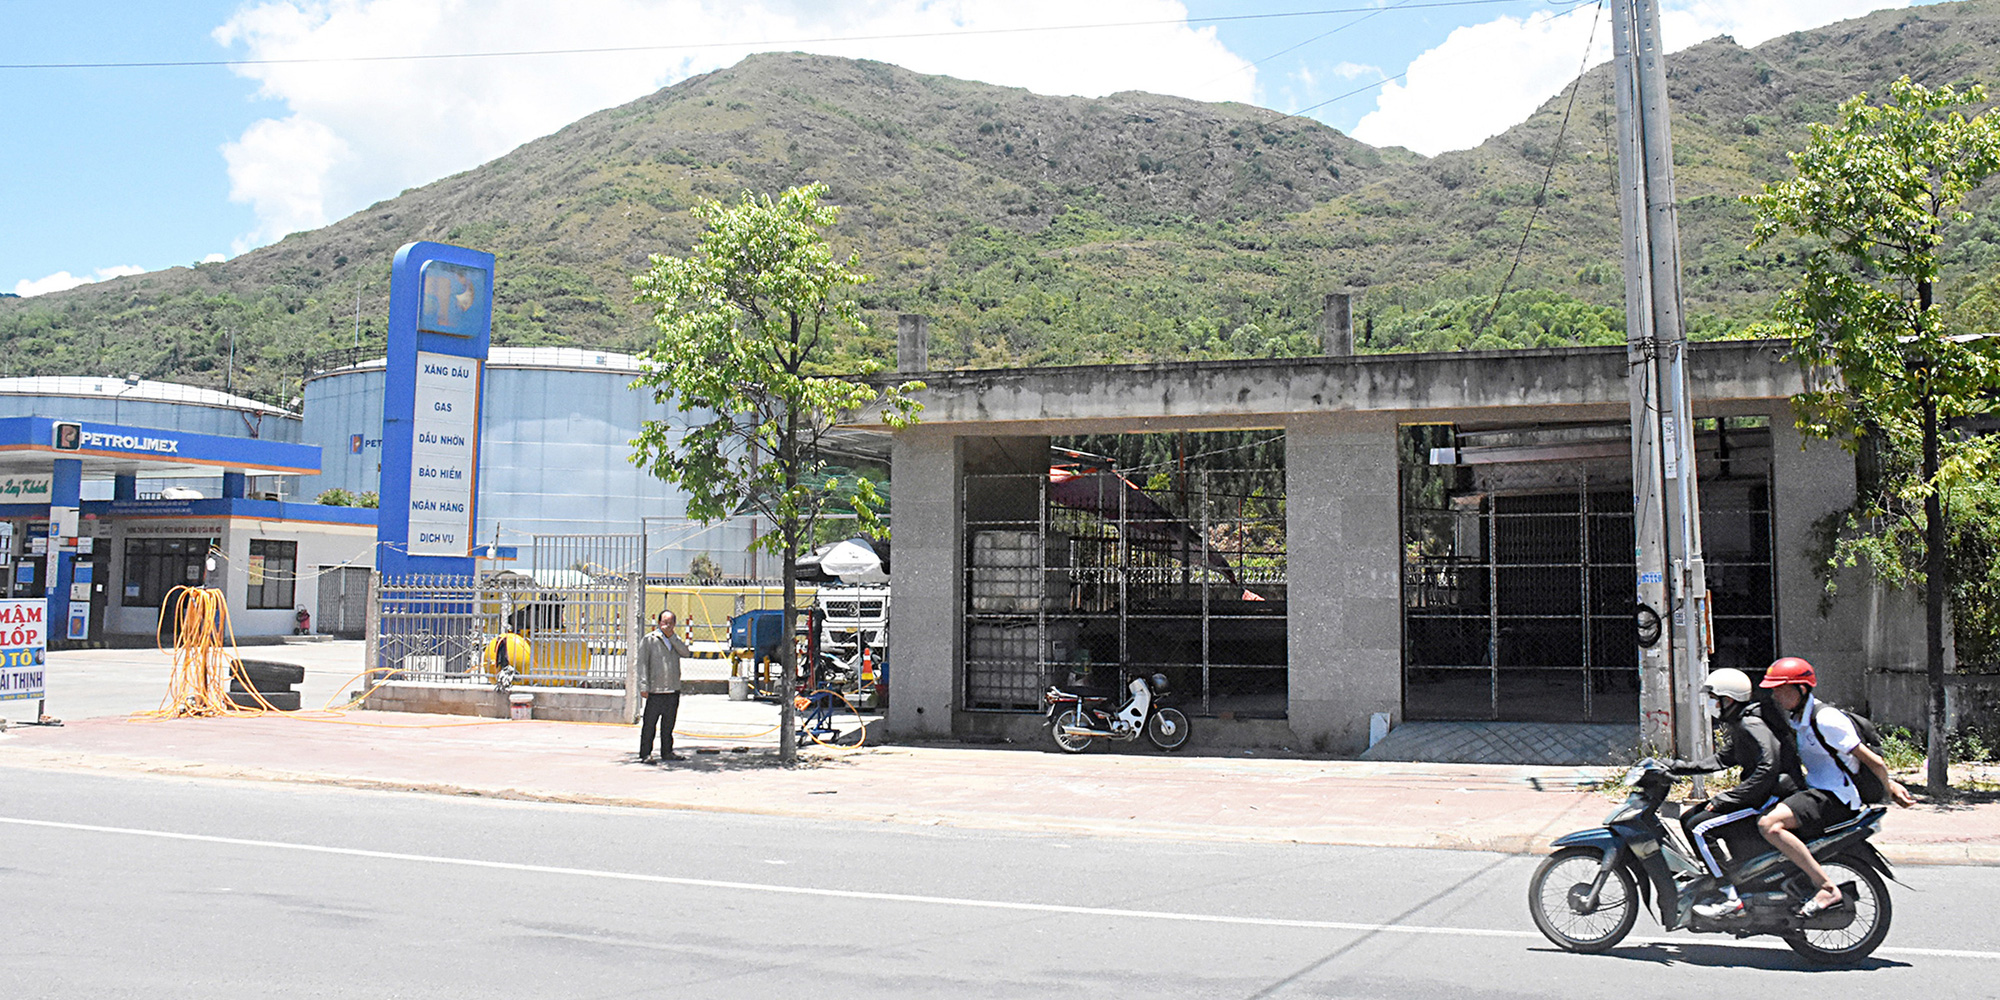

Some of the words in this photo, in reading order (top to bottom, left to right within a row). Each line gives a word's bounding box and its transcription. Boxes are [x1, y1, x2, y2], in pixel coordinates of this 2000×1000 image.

[434, 402, 452, 413] GAS
[81, 431, 178, 453] PETROLIMEX
[9, 648, 33, 667] TÔ
[13, 671, 43, 692] THỊNH
